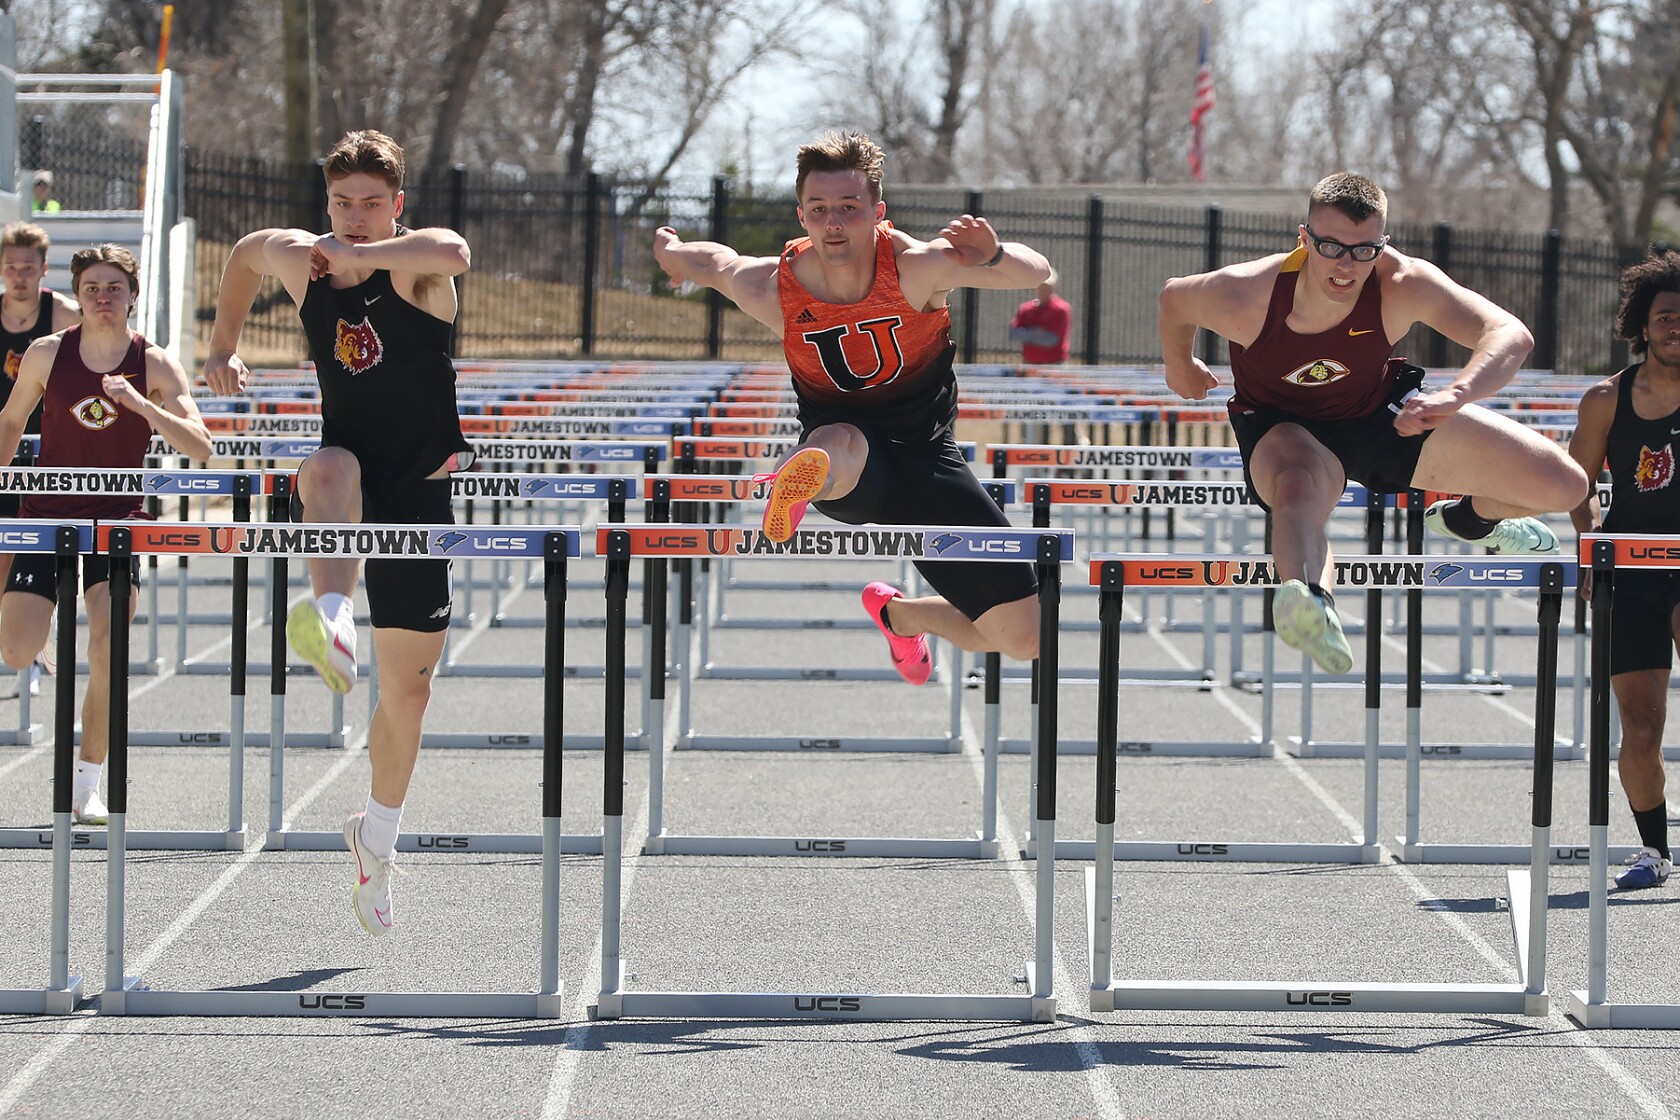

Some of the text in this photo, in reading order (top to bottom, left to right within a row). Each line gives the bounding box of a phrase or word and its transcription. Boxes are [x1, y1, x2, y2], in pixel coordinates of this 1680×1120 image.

[803, 316, 904, 392] U
[249, 419, 324, 432] JAMESTO
[511, 421, 610, 434] JAMESTOWN
[633, 424, 664, 433] UCS
[478, 444, 634, 459] MESTOWN UCS
[703, 445, 738, 454] UCS
[744, 442, 758, 458] U
[1016, 449, 1242, 466] UCS U JAMESTOWN UC
[0, 472, 220, 492] JAMESTOWN UCS
[554, 484, 596, 494] UCS
[682, 485, 724, 495] UCS
[730, 480, 750, 500] U
[1062, 484, 1257, 505] UCS U JAMESTOW
[0, 532, 40, 545] CS
[147, 527, 529, 554] UCS U JAMESTOWN UCS
[646, 536, 700, 549] UCS
[705, 528, 733, 555] U
[968, 539, 1022, 553] UCS
[1140, 560, 1524, 586] UCS U JATOWN UCS
[180, 734, 221, 743] UCS
[488, 736, 530, 745] UCS
[800, 740, 842, 749] UCS
[1421, 745, 1462, 754] UCS
[39, 833, 91, 845] US
[418, 836, 469, 848] UCS
[795, 840, 846, 852] UCS
[1177, 844, 1228, 855] UCS
[1557, 848, 1590, 860] UC
[299, 995, 366, 1010] UCS
[794, 996, 862, 1012] UCS
[1287, 992, 1353, 1006] UCS
